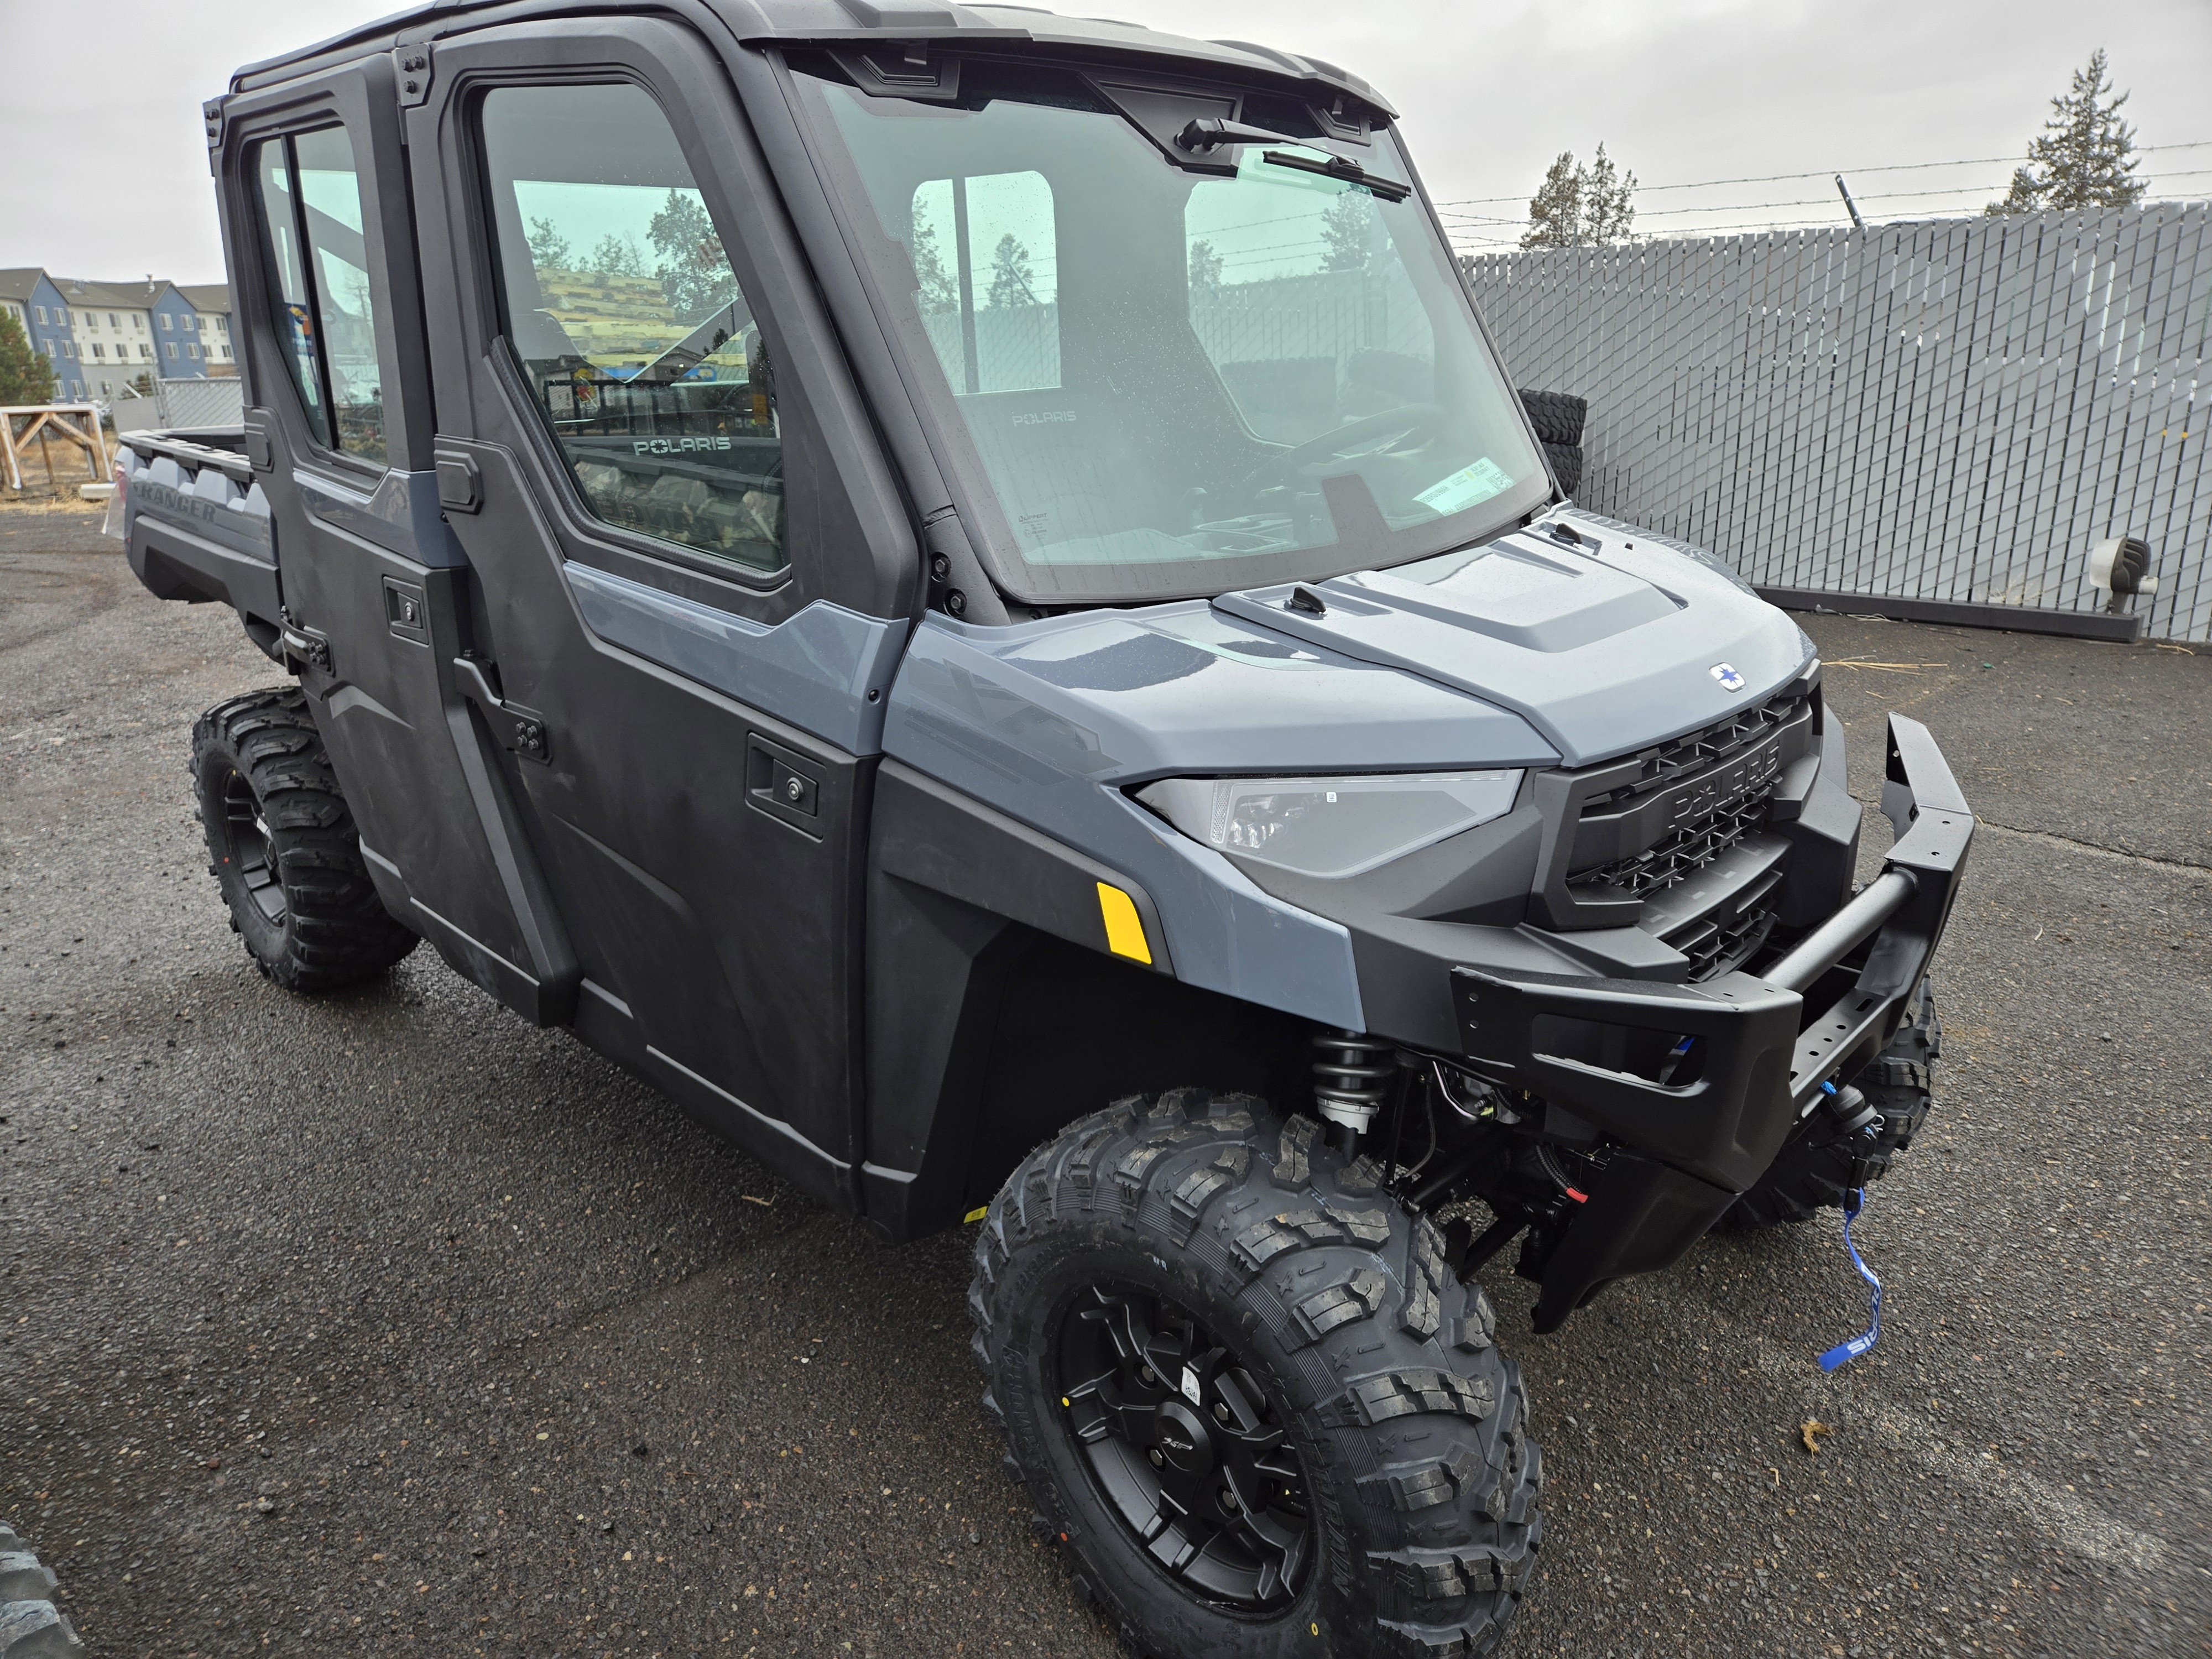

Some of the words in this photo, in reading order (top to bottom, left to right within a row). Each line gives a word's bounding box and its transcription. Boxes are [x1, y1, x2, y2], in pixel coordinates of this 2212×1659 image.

[1012, 411, 1077, 426] POLARIS
[633, 436, 732, 456] POLARIS
[141, 485, 216, 523] RANGER
[1668, 739, 1780, 828] POLARIS
